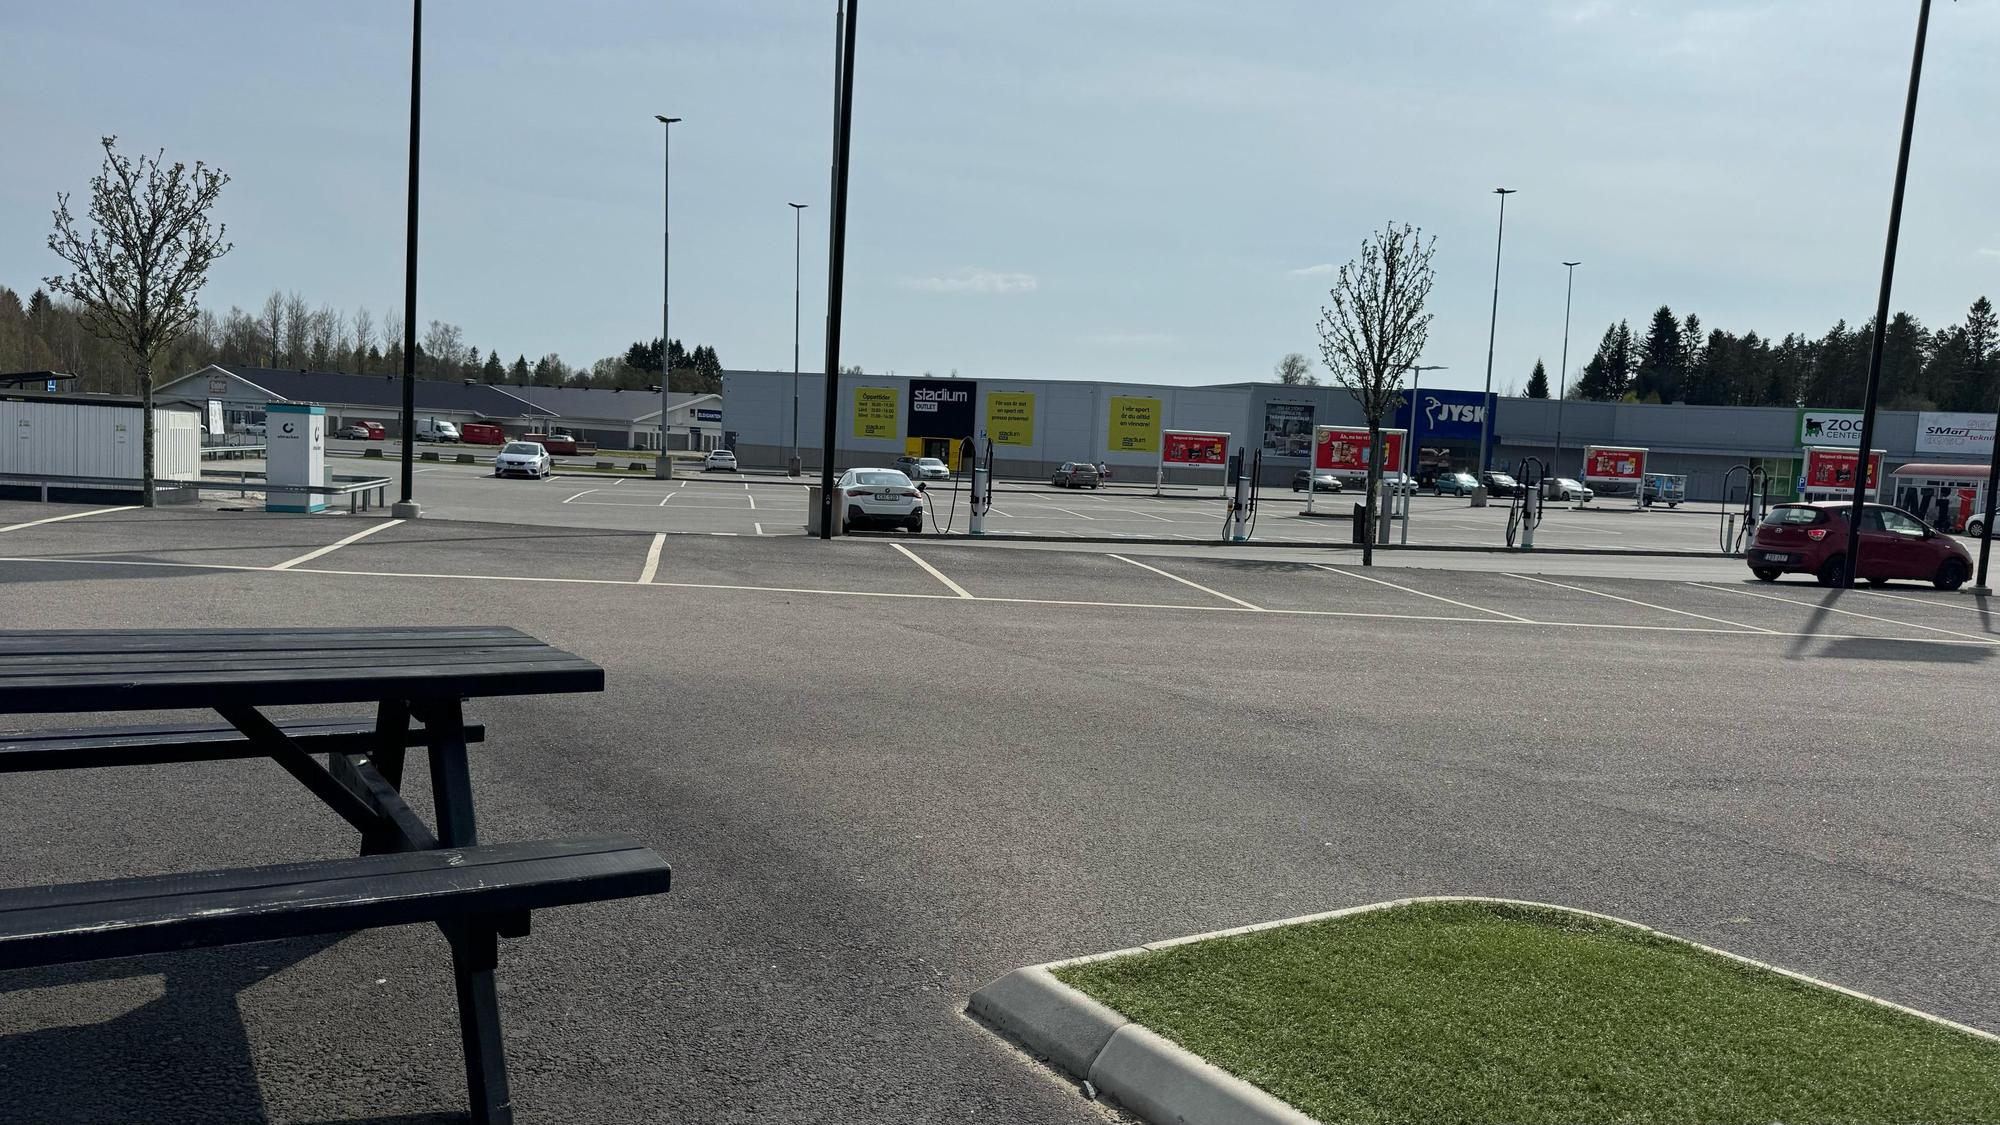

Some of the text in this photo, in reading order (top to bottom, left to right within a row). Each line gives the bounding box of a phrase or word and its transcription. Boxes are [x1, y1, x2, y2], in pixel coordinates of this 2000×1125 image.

[914, 388, 968, 402] stadium
[1438, 404, 1485, 423] JYSK
[1798, 477, 1805, 487] P
